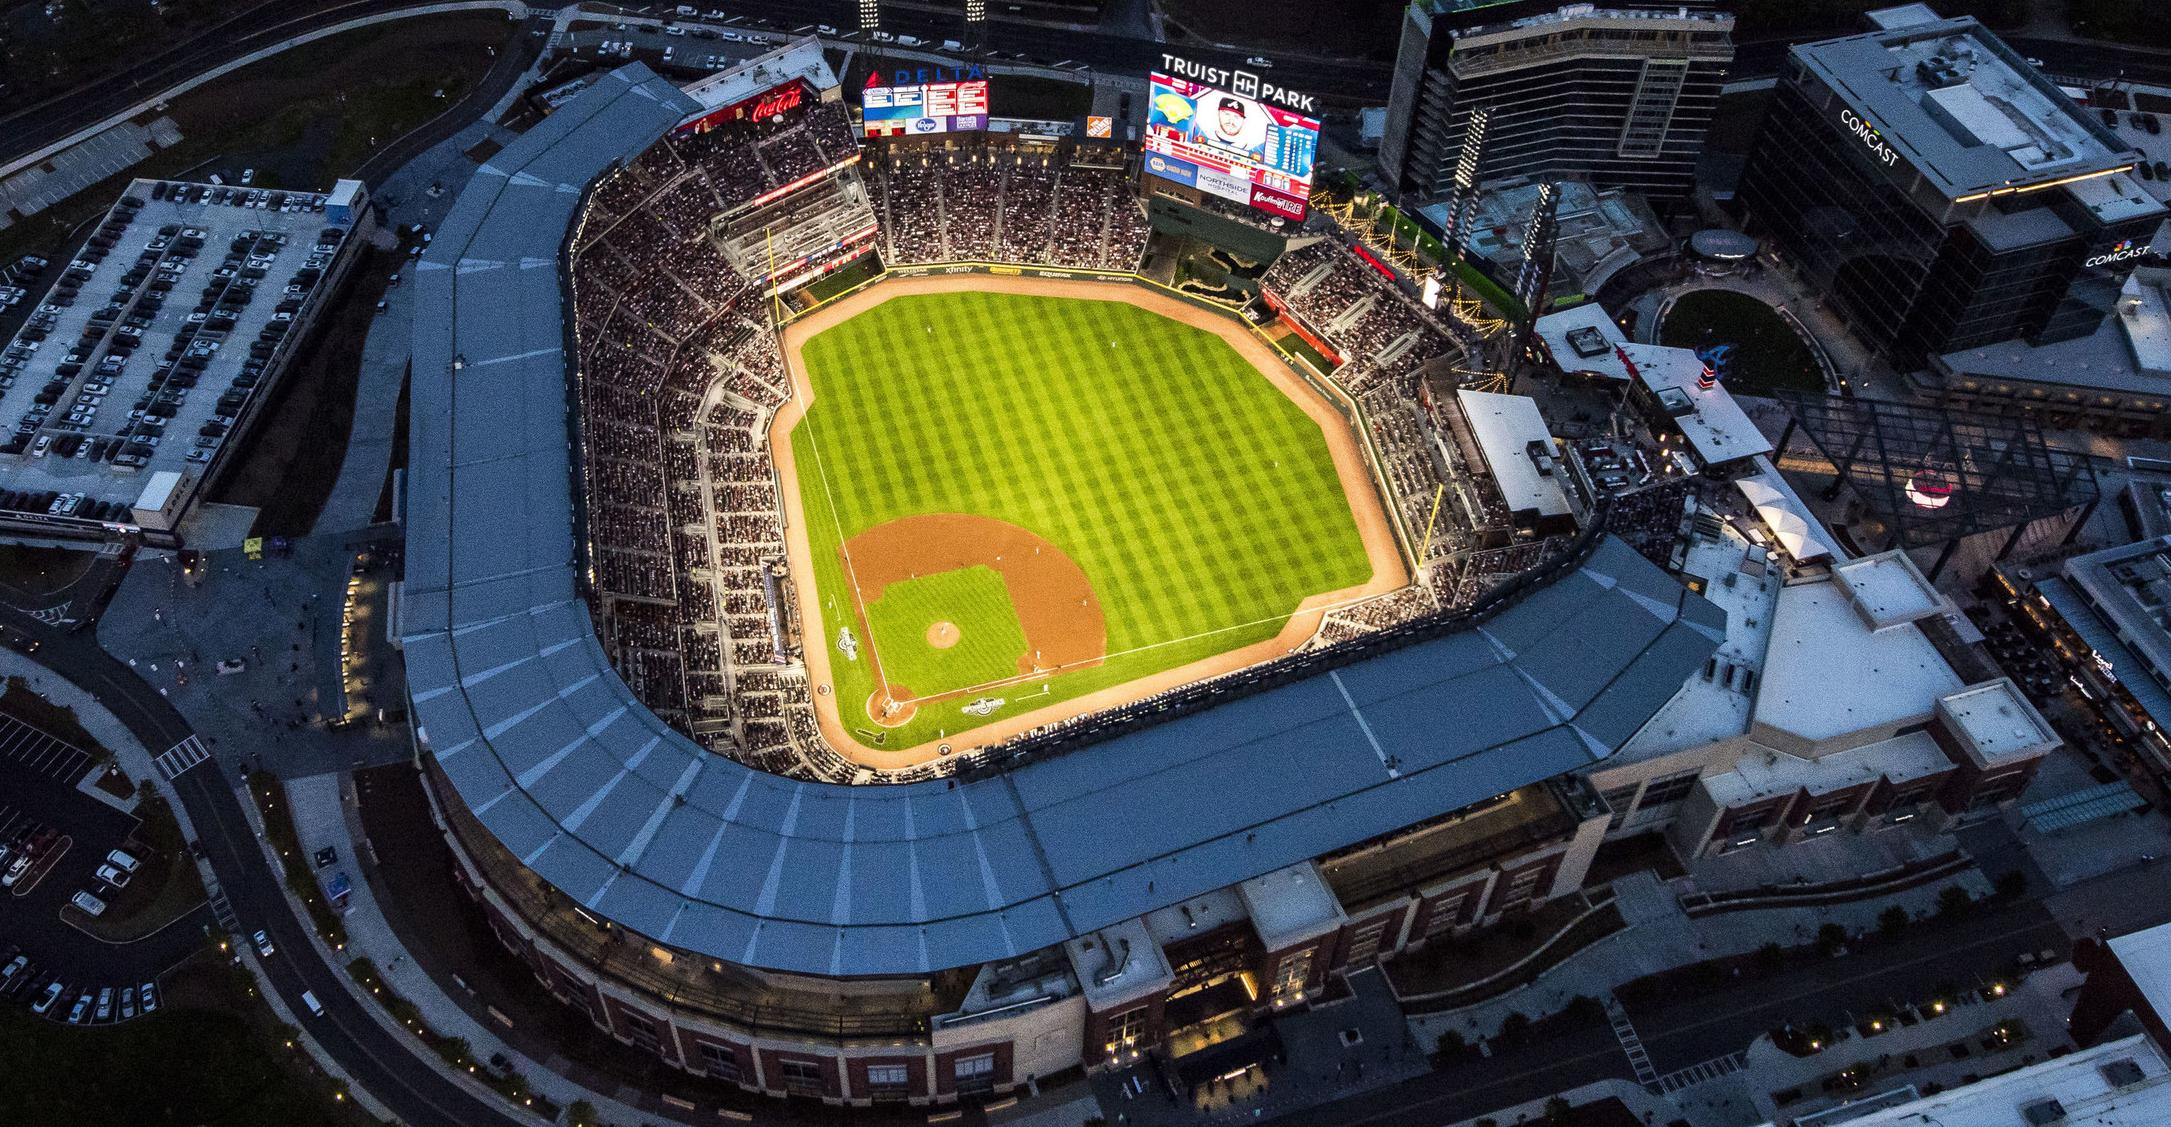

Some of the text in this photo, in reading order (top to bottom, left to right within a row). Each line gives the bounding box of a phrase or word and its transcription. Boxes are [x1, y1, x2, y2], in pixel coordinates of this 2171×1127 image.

[895, 63, 983, 85] DELTA
[1162, 54, 1230, 86] TRUIST
[1262, 84, 1315, 112] PARK
[752, 88, 802, 122] Coca-Cola
[1841, 109, 1899, 167] COMCAST
[1199, 174, 1249, 193] NORTHSIDE
[2085, 245, 2151, 267] COMCAST
[945, 265, 974, 274] xfinity
[1039, 270, 1073, 278] EQUIFAX
